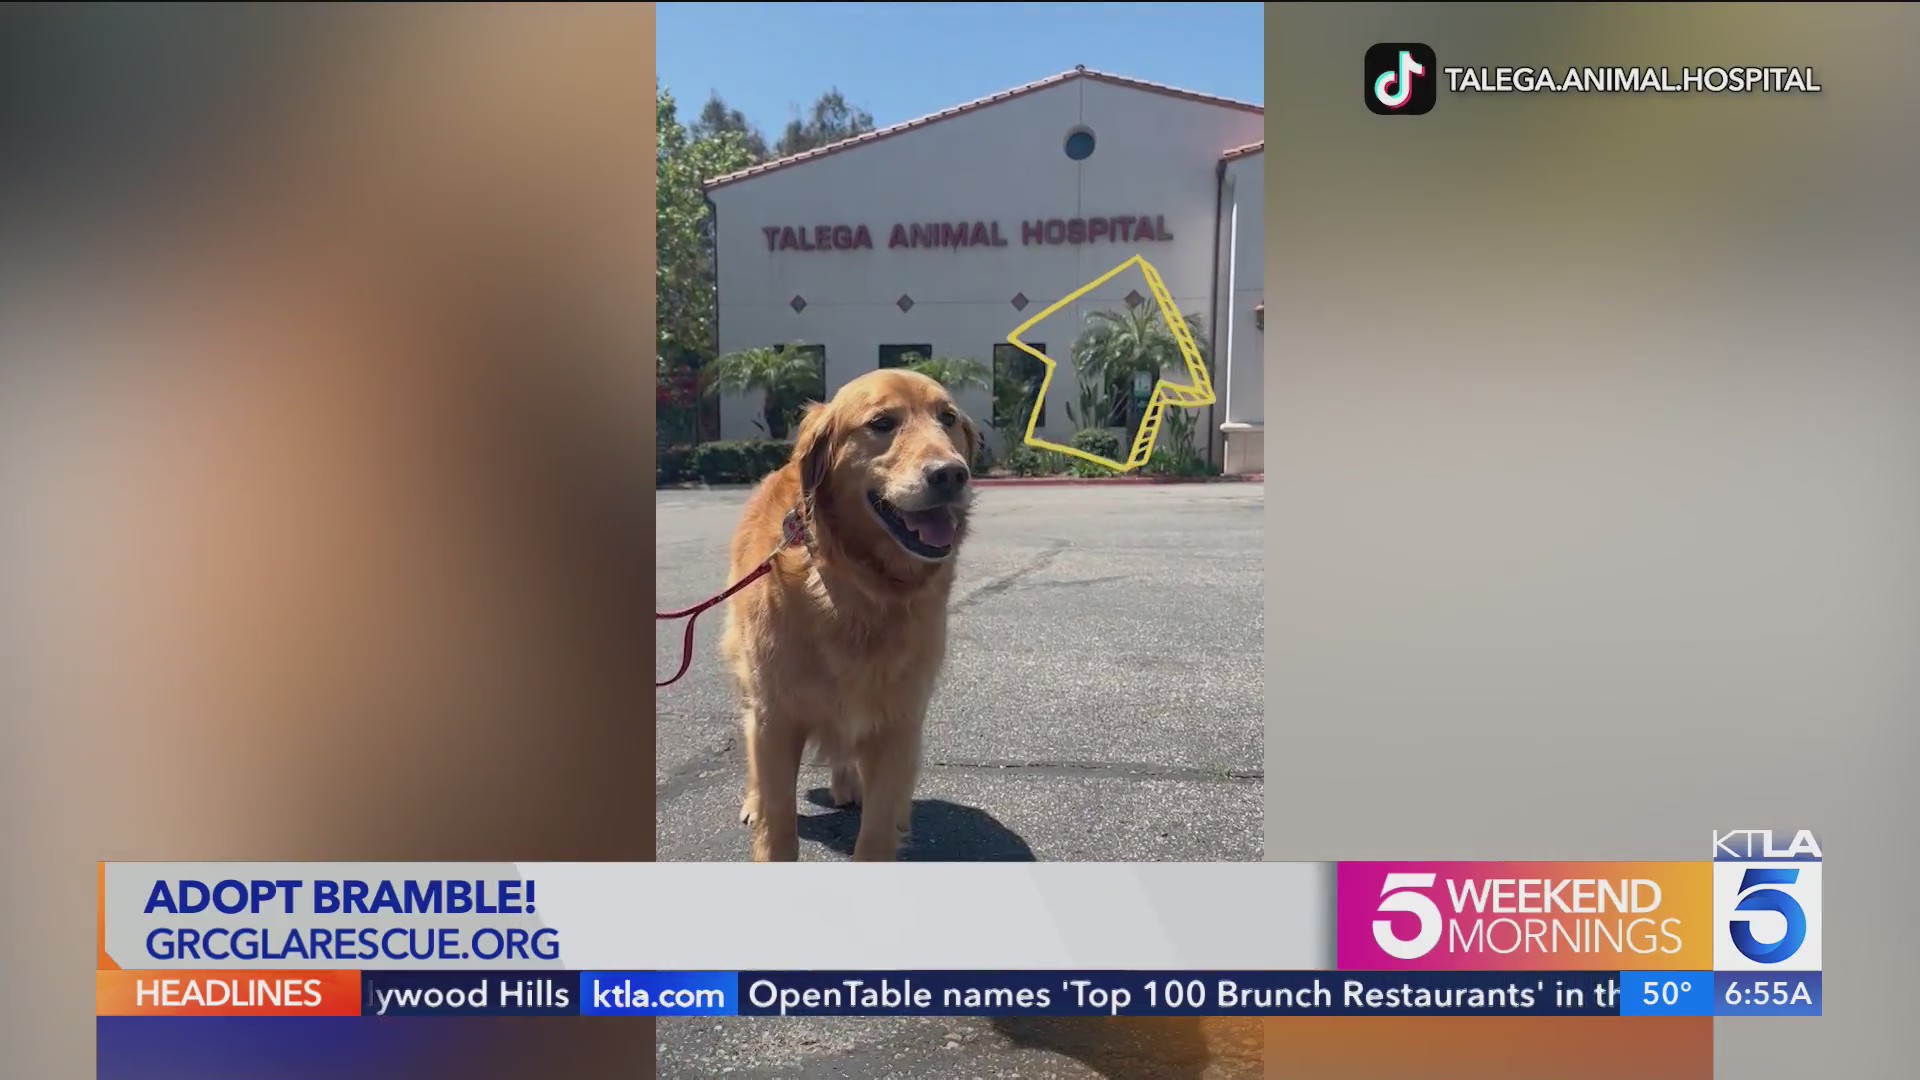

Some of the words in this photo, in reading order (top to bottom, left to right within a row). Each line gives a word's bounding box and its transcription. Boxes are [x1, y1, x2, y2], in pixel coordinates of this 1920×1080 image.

[763, 224, 872, 251] TALEGA
[889, 221, 1007, 249] ANIMAL
[1022, 215, 1173, 246] HOSPITAL
